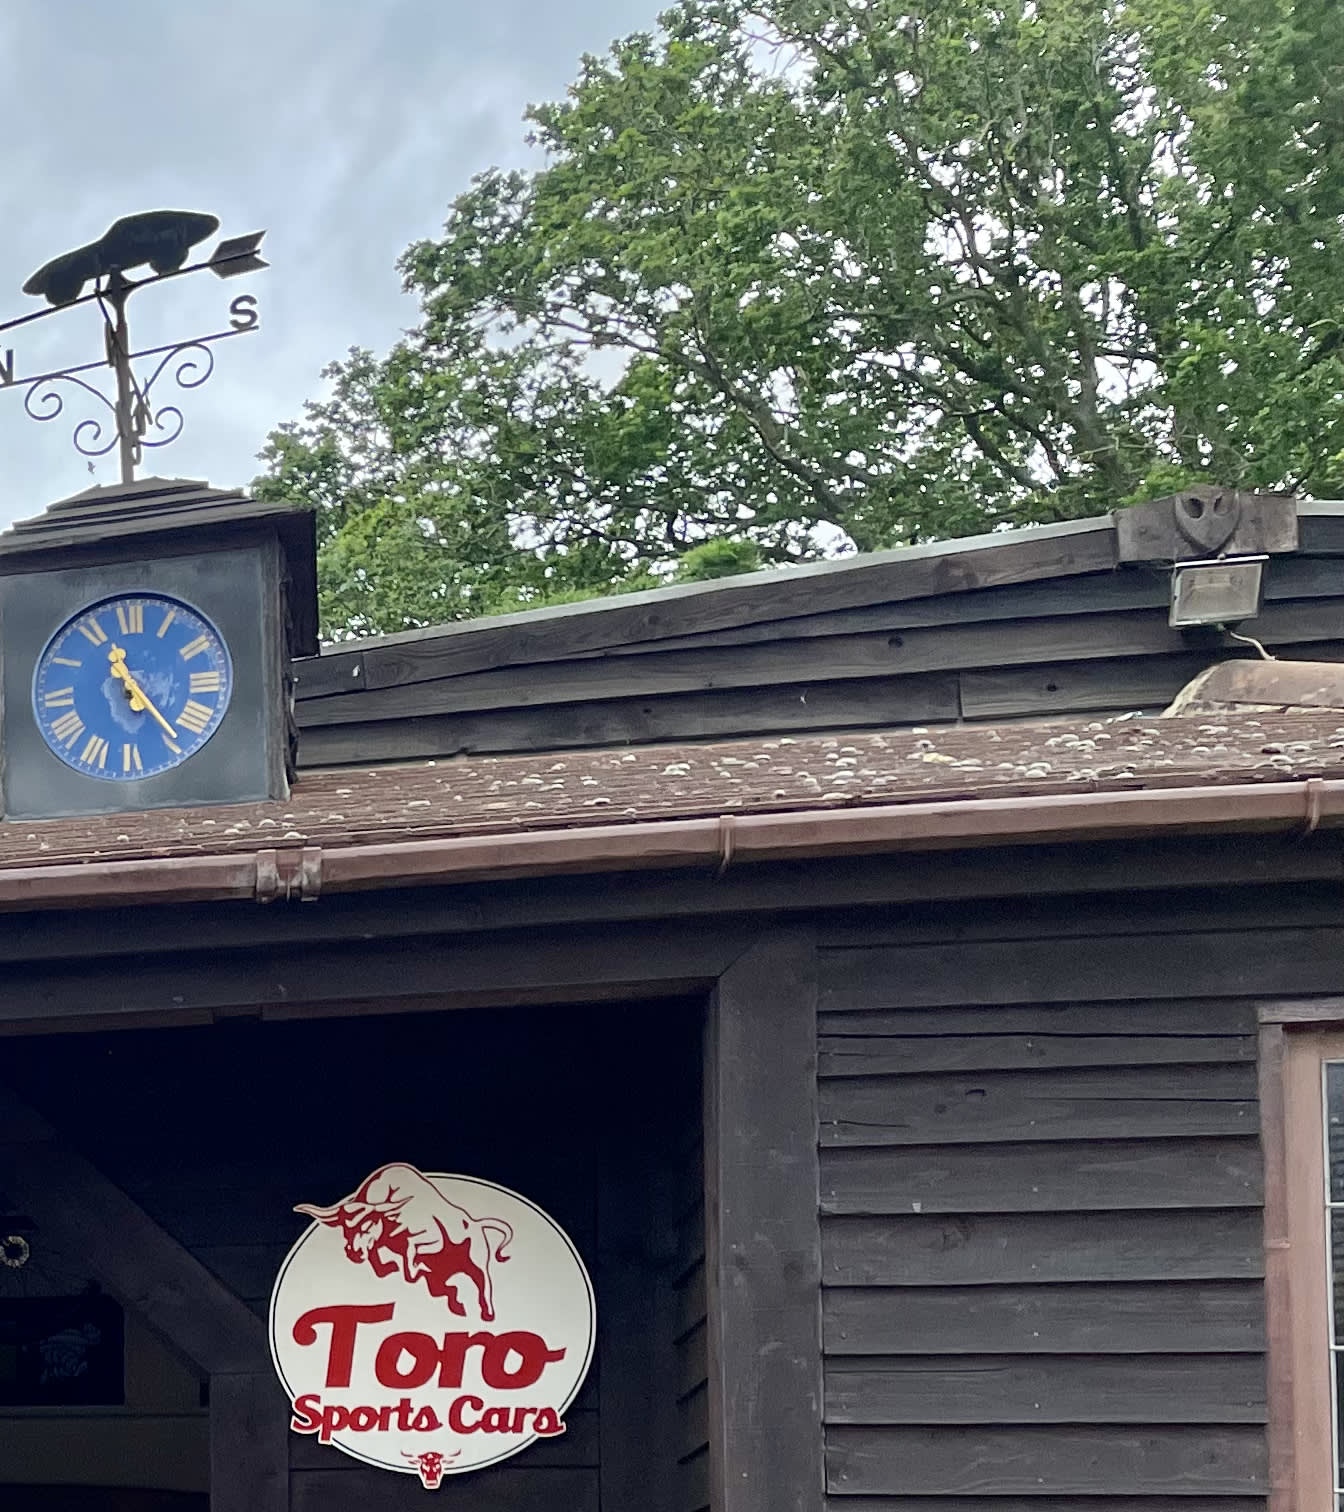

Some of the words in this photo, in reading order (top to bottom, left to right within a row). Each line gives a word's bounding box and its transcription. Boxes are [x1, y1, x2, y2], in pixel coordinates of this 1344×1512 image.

[229, 294, 258, 330] S
[292, 1302, 567, 1390] Toro
[292, 1393, 443, 1442] Sports
[448, 1394, 565, 1434] Cars
